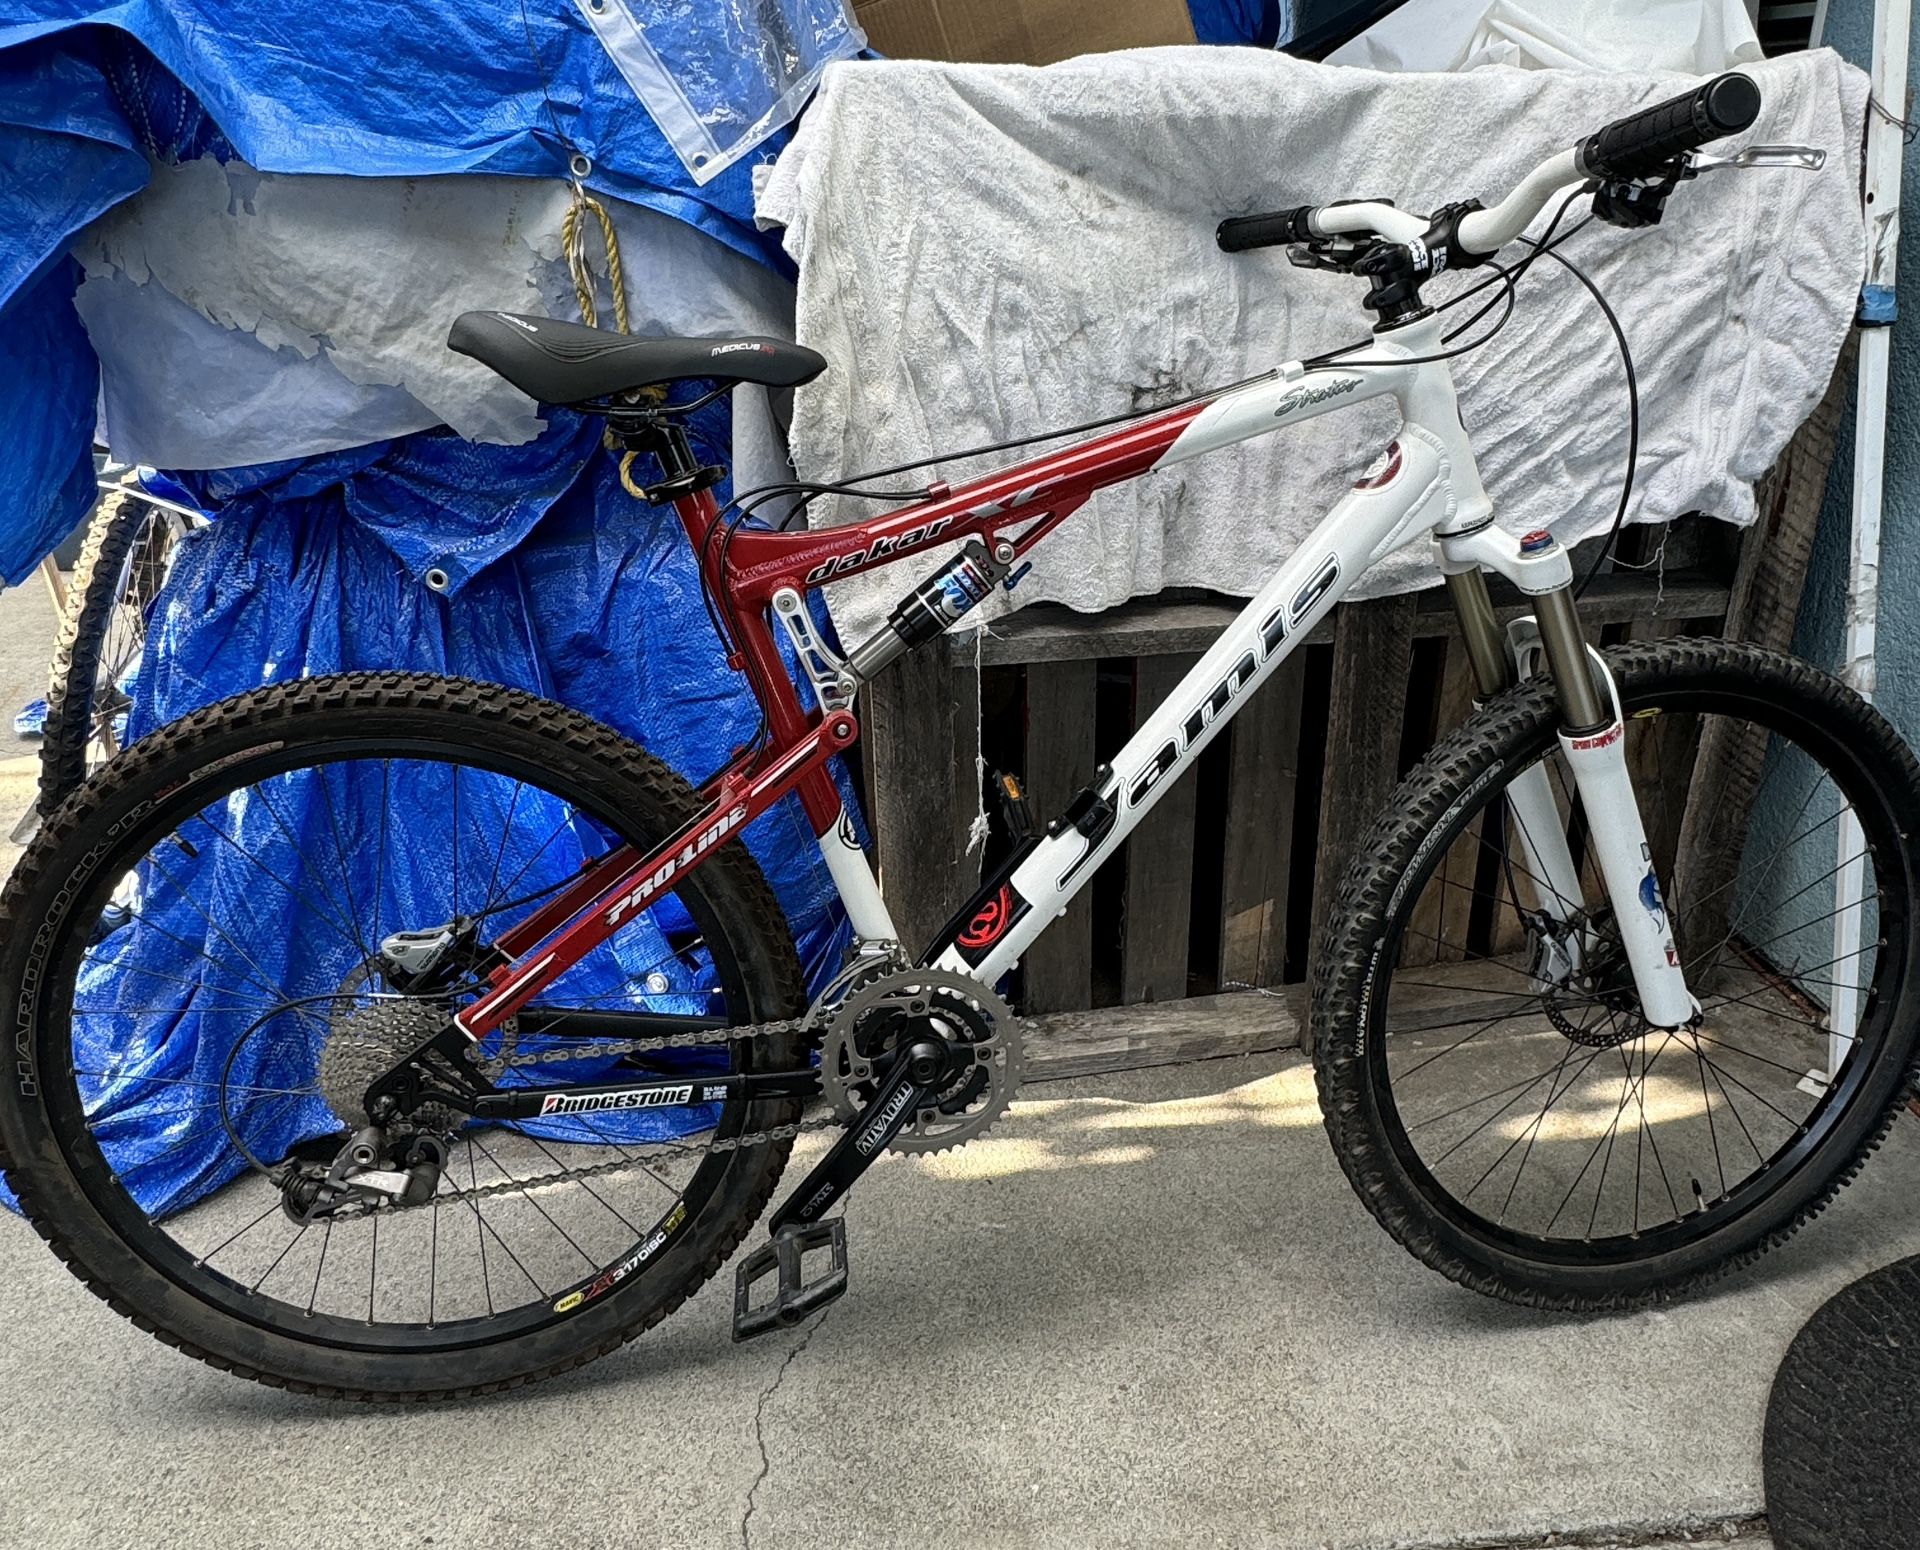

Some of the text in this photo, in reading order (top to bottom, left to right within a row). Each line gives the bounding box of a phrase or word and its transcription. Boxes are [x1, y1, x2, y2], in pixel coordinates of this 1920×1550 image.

[805, 515, 955, 584] dakar
[541, 1086, 691, 1116] BRIDGESTONE
[862, 1082, 912, 1154] TRUVATIV
